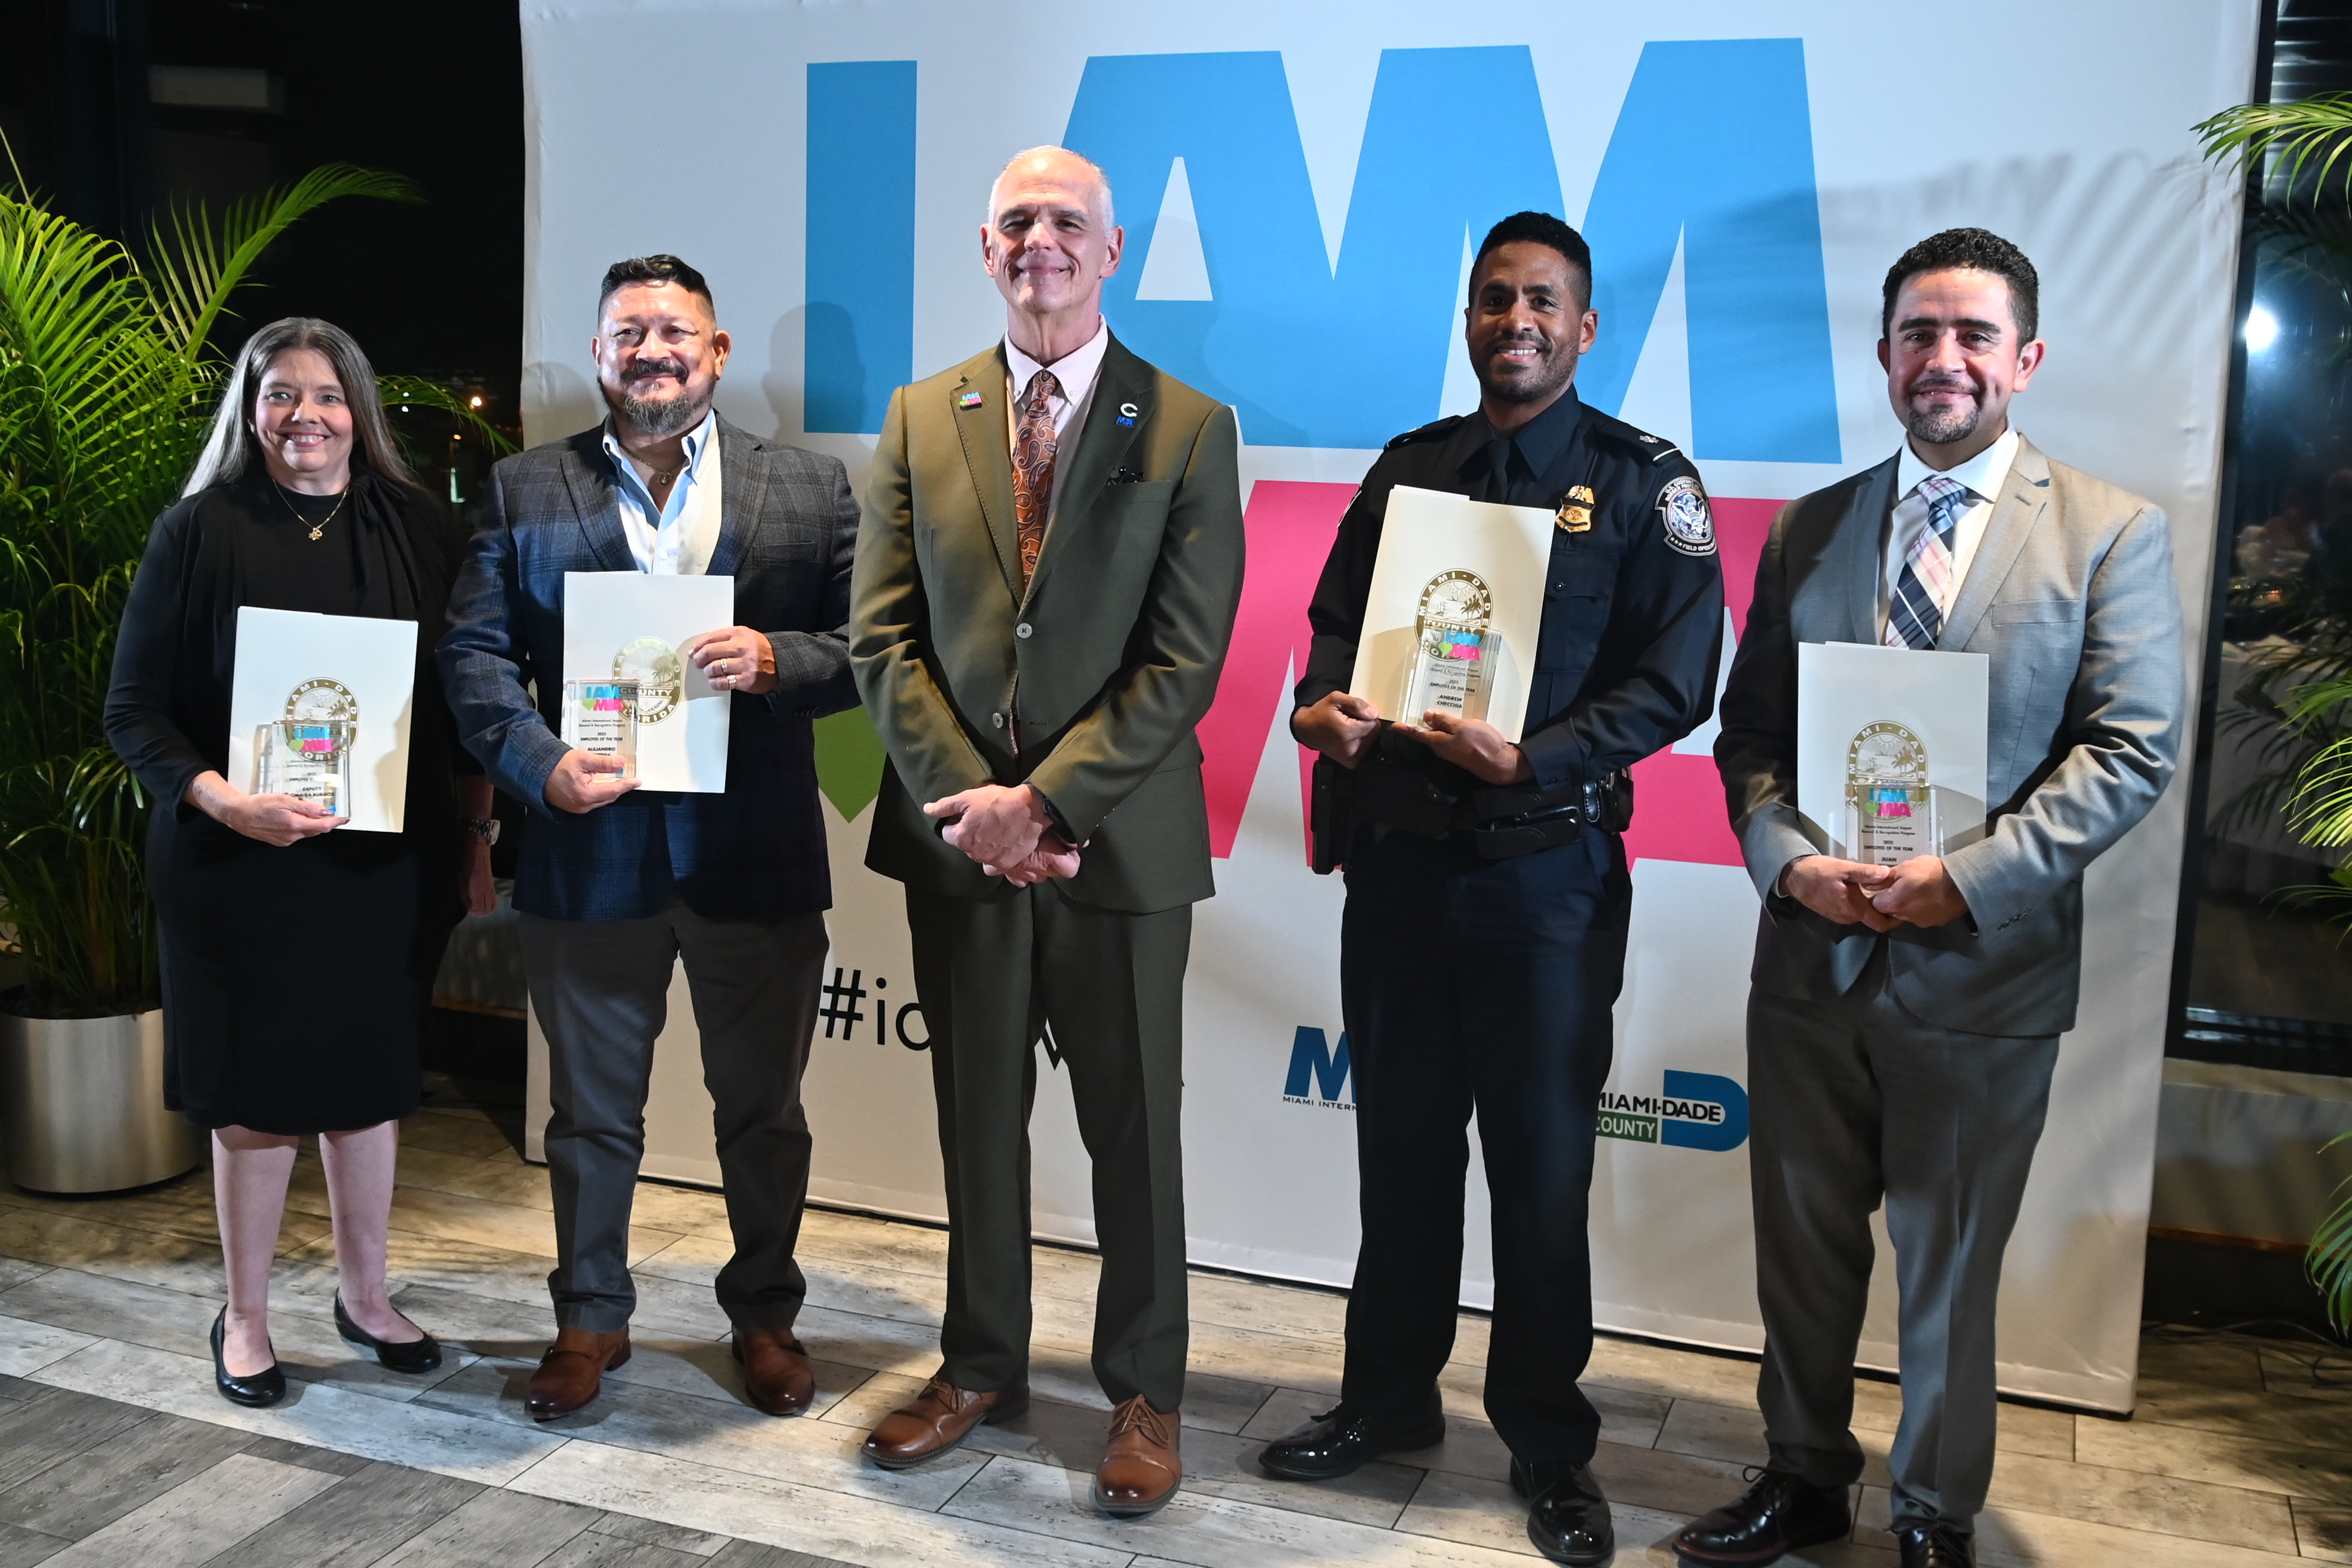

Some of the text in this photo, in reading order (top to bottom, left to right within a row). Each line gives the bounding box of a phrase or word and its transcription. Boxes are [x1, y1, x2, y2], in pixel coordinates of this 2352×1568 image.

[804, 37, 1842, 464] I AM
[593, 687, 620, 699] AM
[1283, 1096, 1314, 1106] MIAMI
